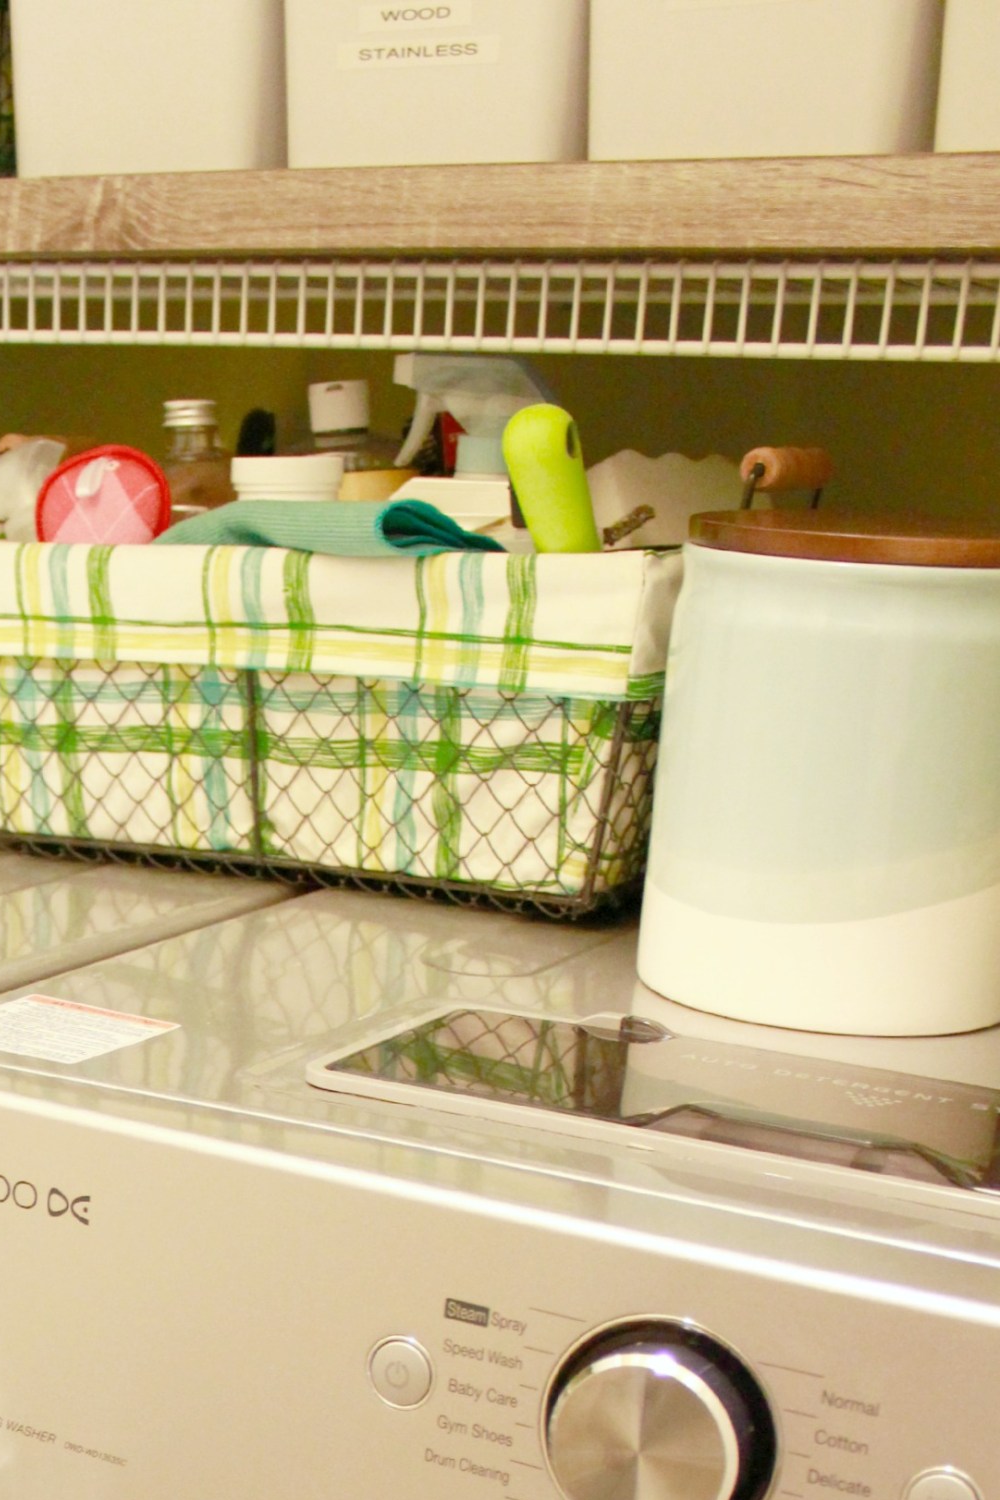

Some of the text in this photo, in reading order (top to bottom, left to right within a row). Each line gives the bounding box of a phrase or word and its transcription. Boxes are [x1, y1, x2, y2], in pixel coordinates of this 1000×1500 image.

[381, 6, 451, 22] WOOD
[358, 43, 479, 61] STAINLESS
[771, 1067, 954, 1105] DETERGENT
[446, 1301, 528, 1336] Steam Spray
[443, 1338, 524, 1371] Speed Wash
[448, 1377, 519, 1409] Baby Care
[820, 1389, 881, 1418] Normal
[5, 1419, 58, 1445] WASHER
[436, 1414, 514, 1448] Gym Shoes
[813, 1428, 870, 1456] Cotton
[424, 1447, 511, 1487] Drum Cleaning
[806, 1467, 872, 1498] Delicate
